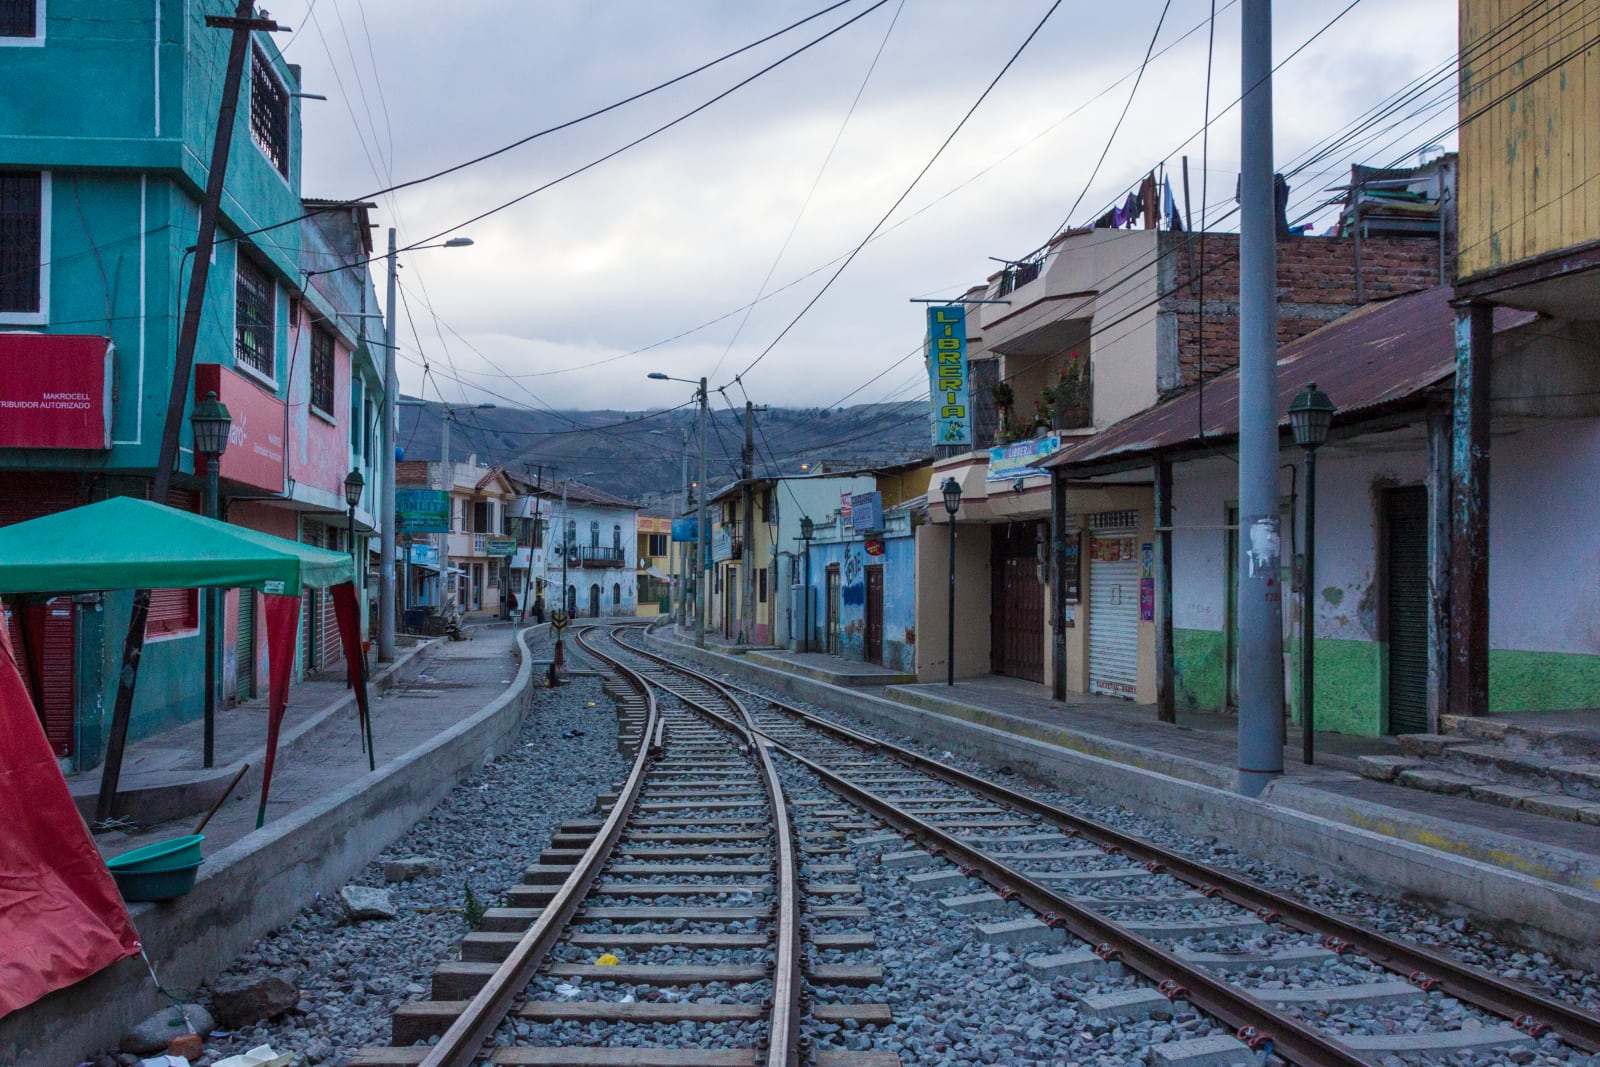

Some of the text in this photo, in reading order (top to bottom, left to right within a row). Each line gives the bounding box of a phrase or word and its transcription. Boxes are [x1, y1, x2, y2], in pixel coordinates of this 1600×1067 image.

[936, 311, 966, 419] LIBRERIA
[43, 393, 91, 401] MAKROCELL
[0, 401, 39, 409] RIBUIDOR
